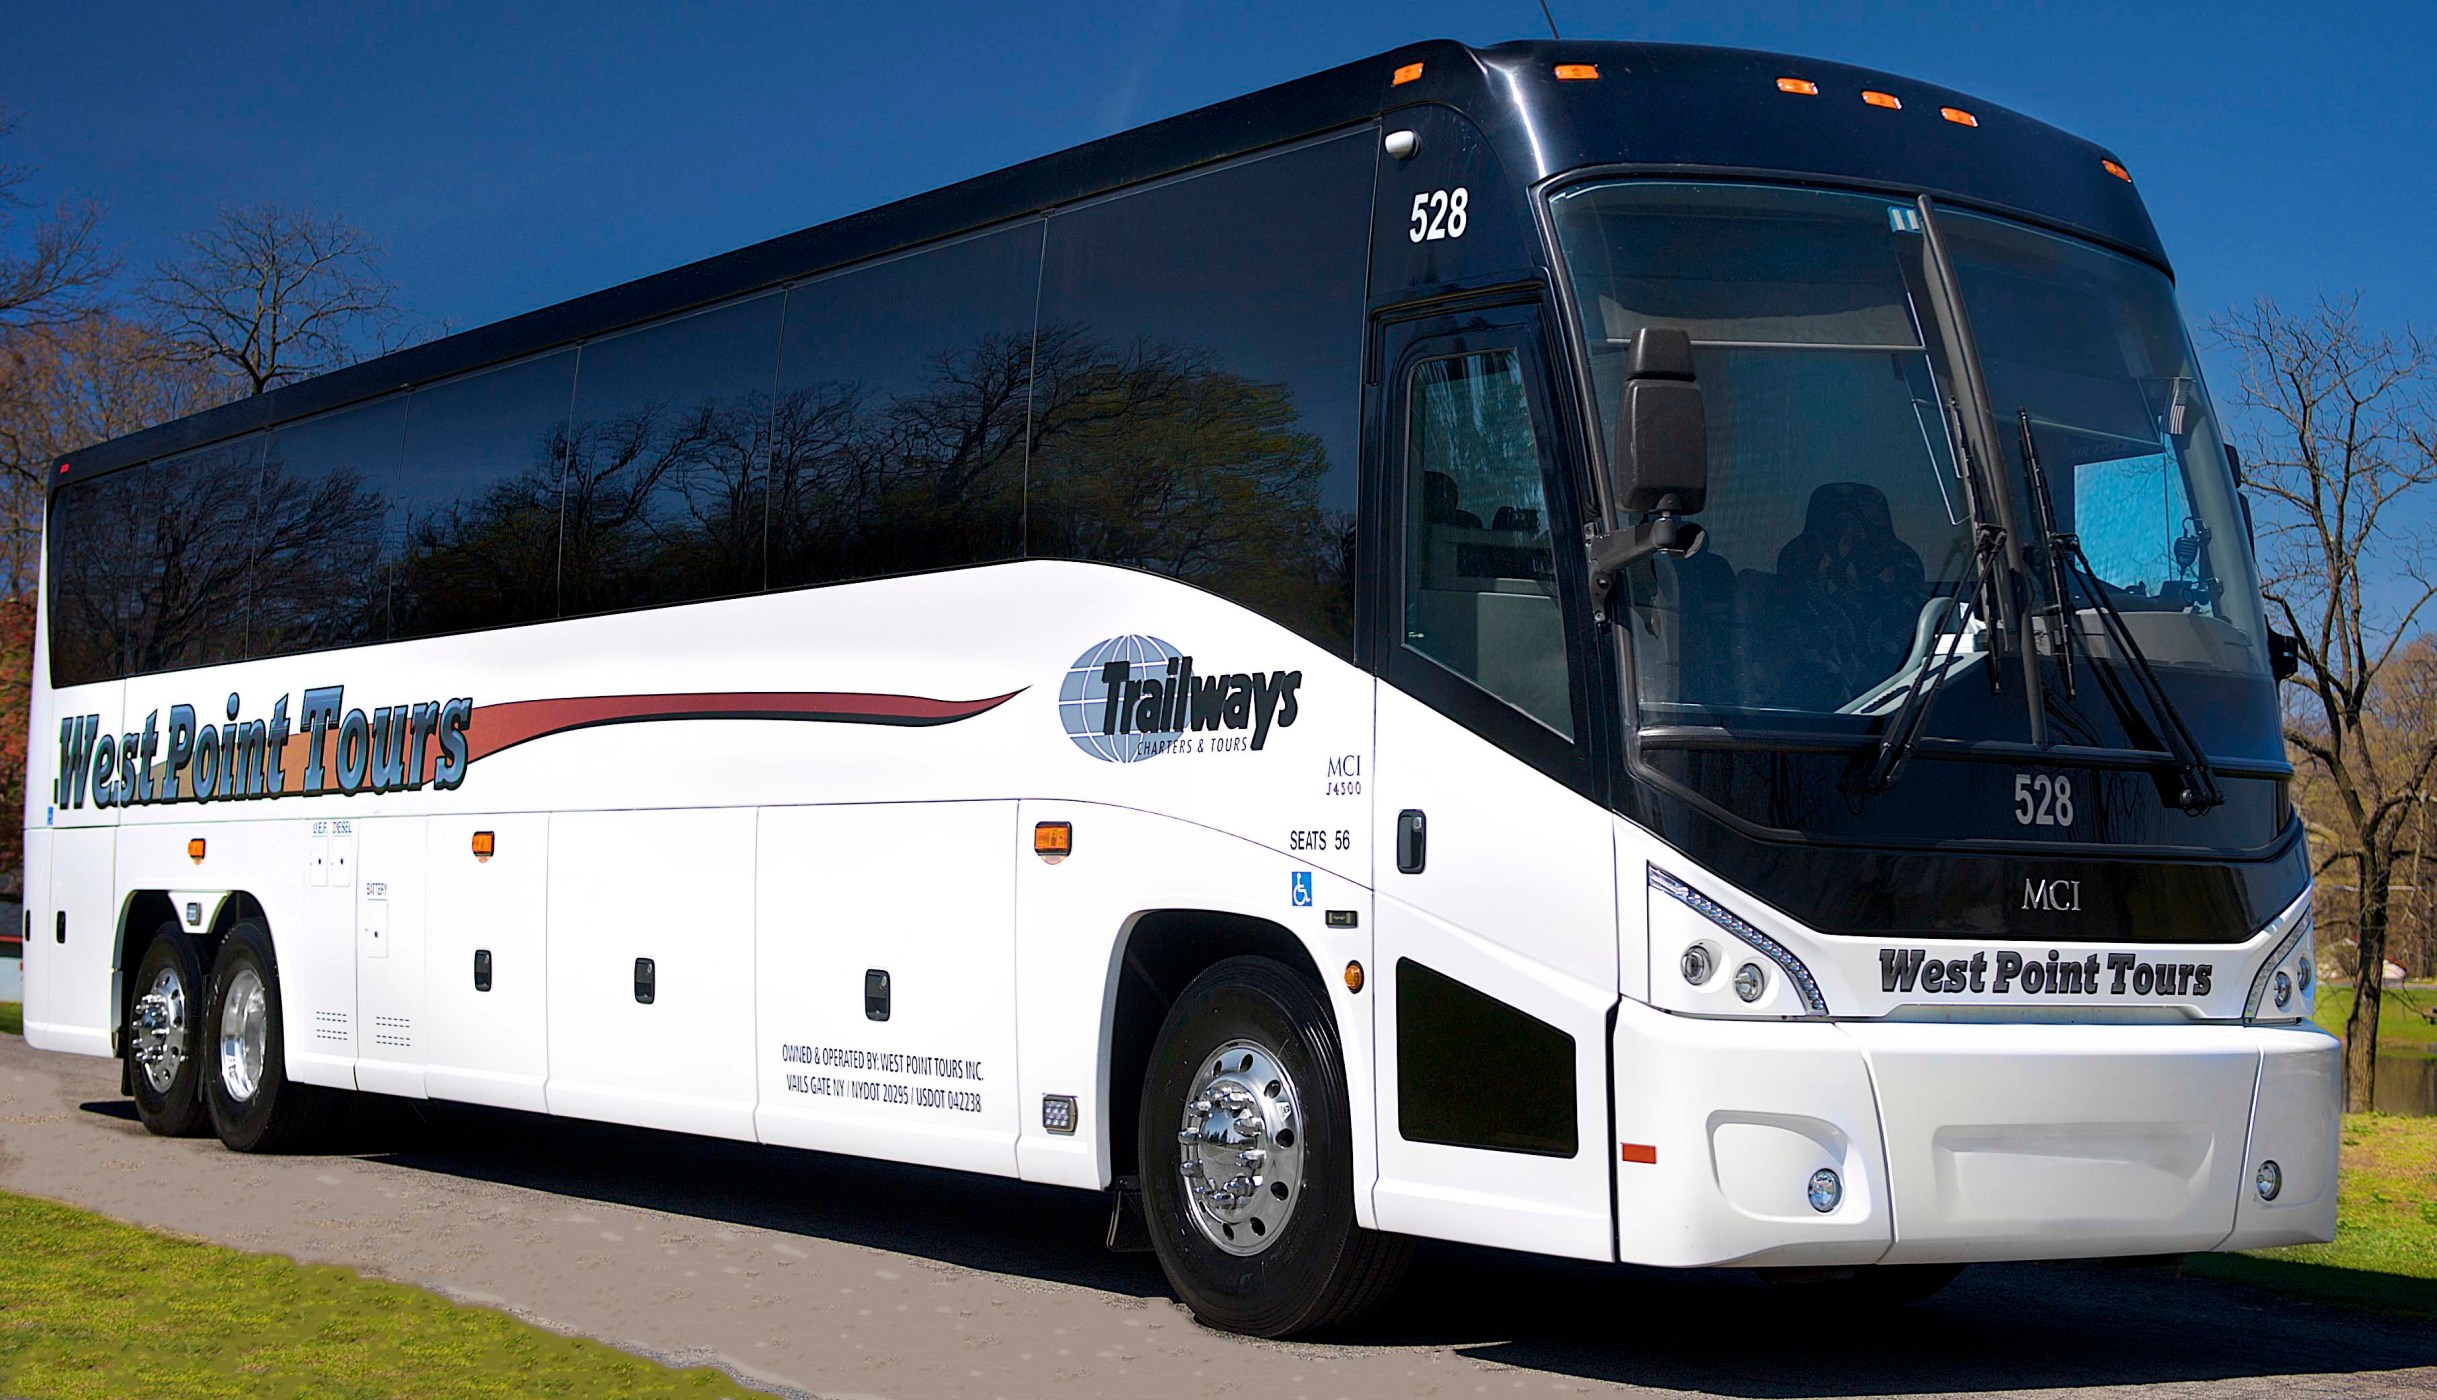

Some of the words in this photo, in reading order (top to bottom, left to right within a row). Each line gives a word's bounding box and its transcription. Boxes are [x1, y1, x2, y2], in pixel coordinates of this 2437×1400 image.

[1409, 187, 1469, 243] 528
[1101, 656, 1303, 751] Trailways
[55, 708, 159, 810] West
[162, 691, 290, 804] Point
[300, 684, 474, 796] Tours
[1137, 739, 1193, 756] CHARTERS
[1197, 738, 1204, 753] &
[1210, 736, 1248, 752] TOURS
[1327, 754, 1361, 778] MCI
[1326, 781, 1362, 796] J4500
[2014, 774, 2075, 827] 528
[1289, 829, 1327, 851] SEATS
[1334, 829, 1351, 851] 56
[2021, 878, 2082, 912] MCI
[1878, 948, 1987, 994] West
[1992, 949, 2101, 995] Point
[2106, 952, 2213, 996] Tours
[782, 1043, 813, 1064] OWNED
[814, 1046, 821, 1065] &
[822, 1047, 865, 1070] OPERATED
[880, 1053, 904, 1073] WEST
[906, 1055, 933, 1076] POINT
[934, 1057, 963, 1079] TOURS
[965, 1060, 984, 1081] INC.
[786, 1073, 809, 1094] VAILS
[810, 1076, 832, 1096] GATE
[833, 1078, 845, 1098] NY
[851, 1080, 881, 1101] NYDOT
[883, 1083, 909, 1105] 20295
[916, 1087, 946, 1109] USDOT
[947, 1090, 982, 1113] 042238
